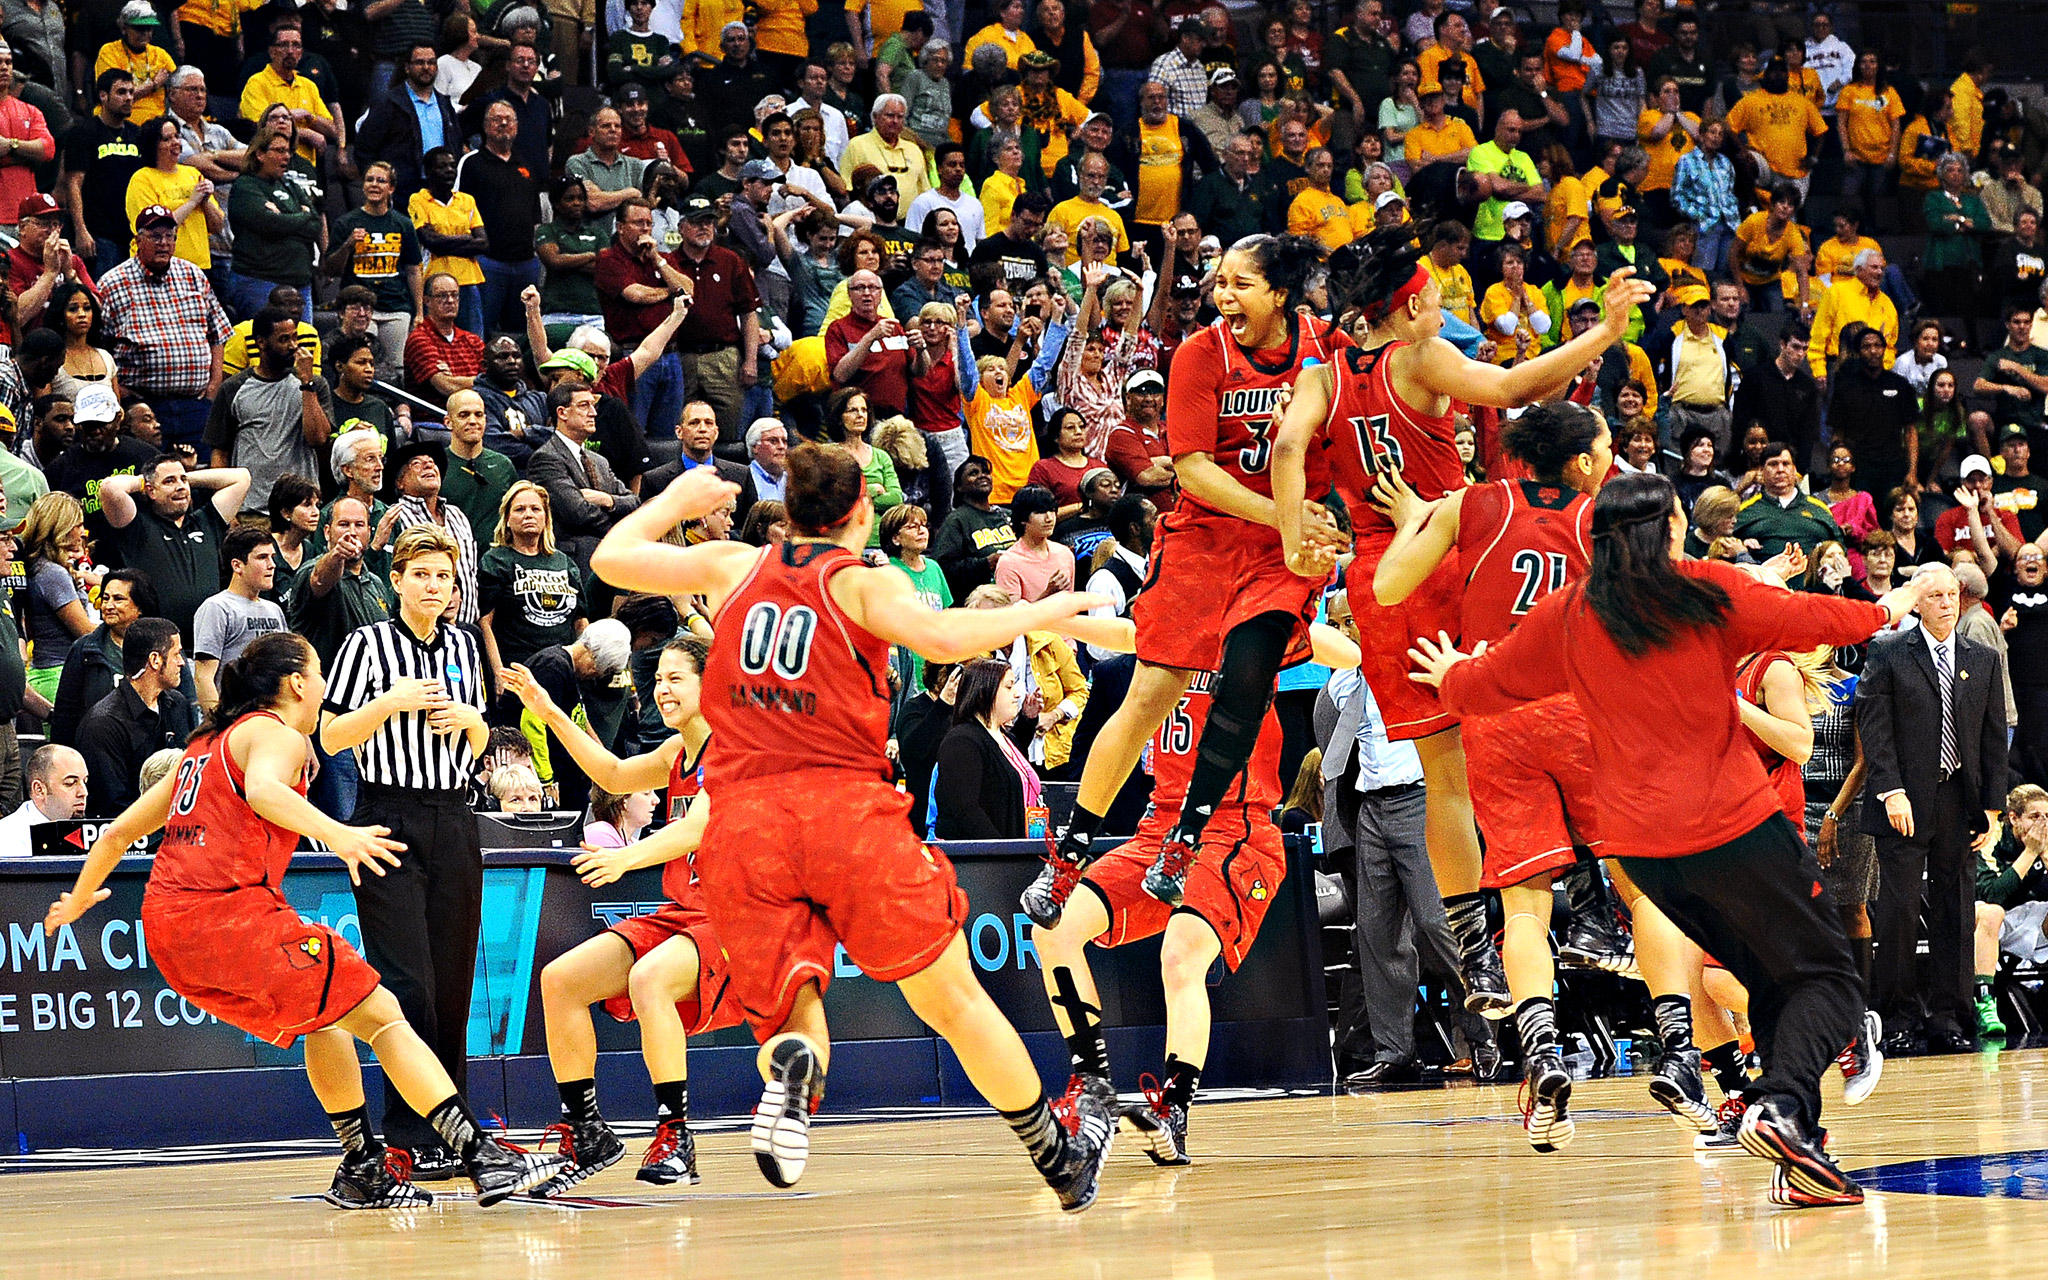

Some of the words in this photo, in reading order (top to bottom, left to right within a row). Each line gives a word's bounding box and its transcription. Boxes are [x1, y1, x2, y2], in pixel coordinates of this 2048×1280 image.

[1239, 418, 1273, 474] 3
[1347, 413, 1405, 477] 13
[1510, 548, 1568, 616] 21
[739, 601, 818, 681] 00
[1160, 697, 1193, 755] 15
[31, 991, 96, 1032] BIG
[106, 990, 144, 1029] 12
